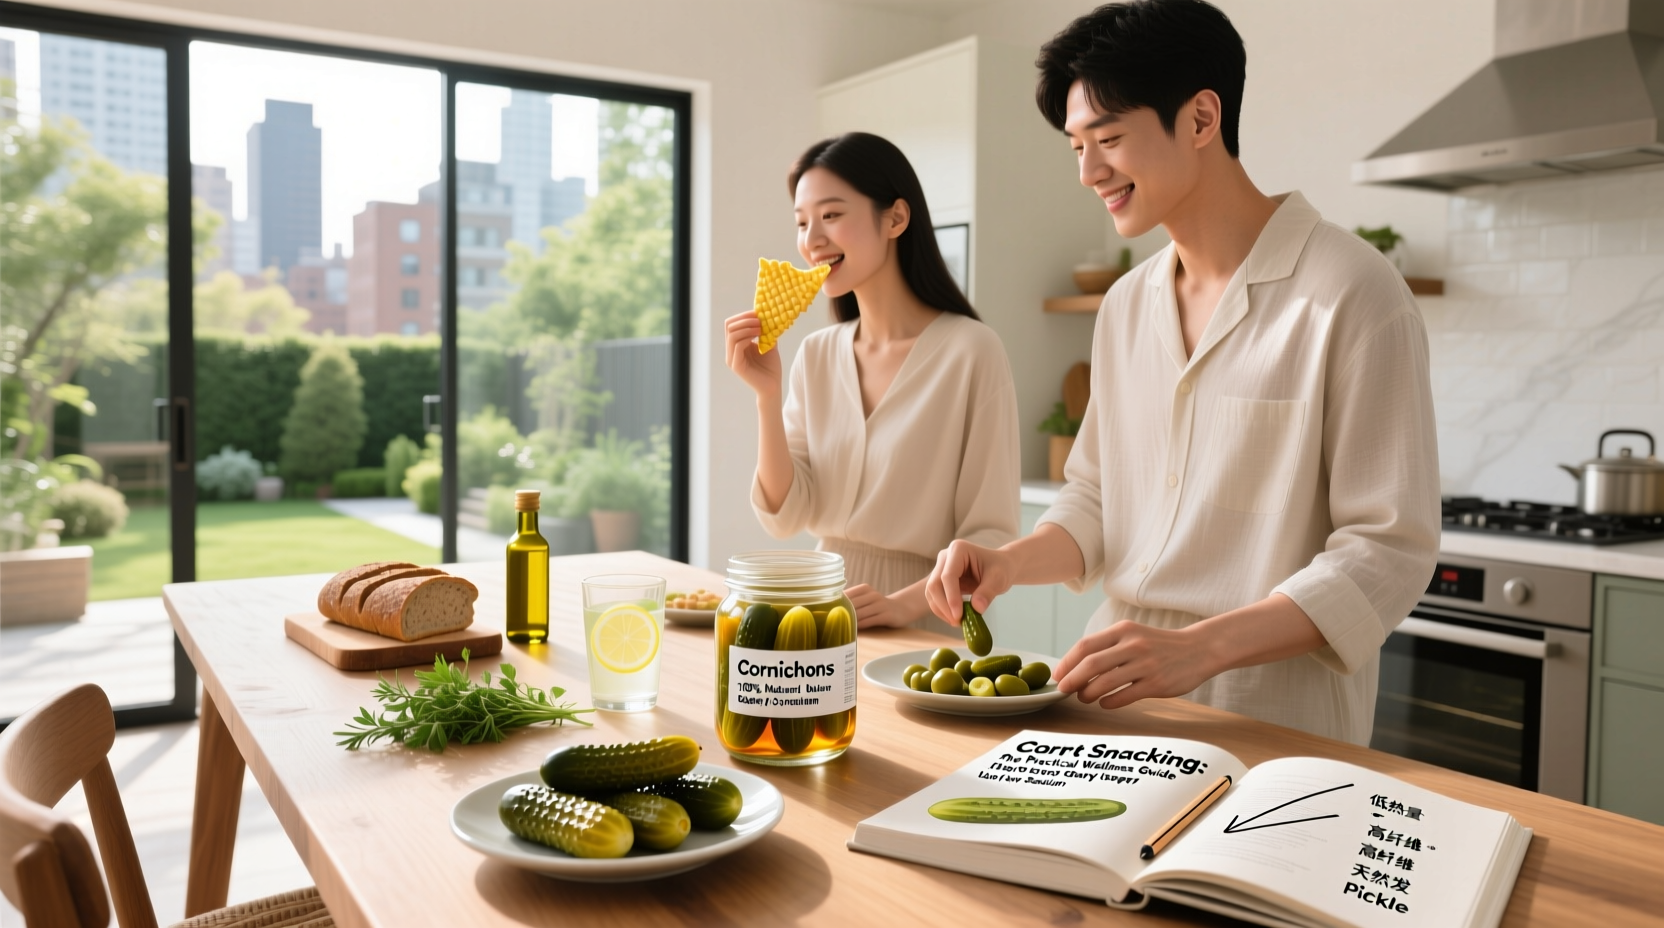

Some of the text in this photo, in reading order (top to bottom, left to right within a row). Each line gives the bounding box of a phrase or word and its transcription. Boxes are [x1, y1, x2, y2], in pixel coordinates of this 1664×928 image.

[738, 659, 834, 678] Cornichons
[1087, 743, 1209, 775] Snacking:
[1342, 880, 1409, 914] Pickle
